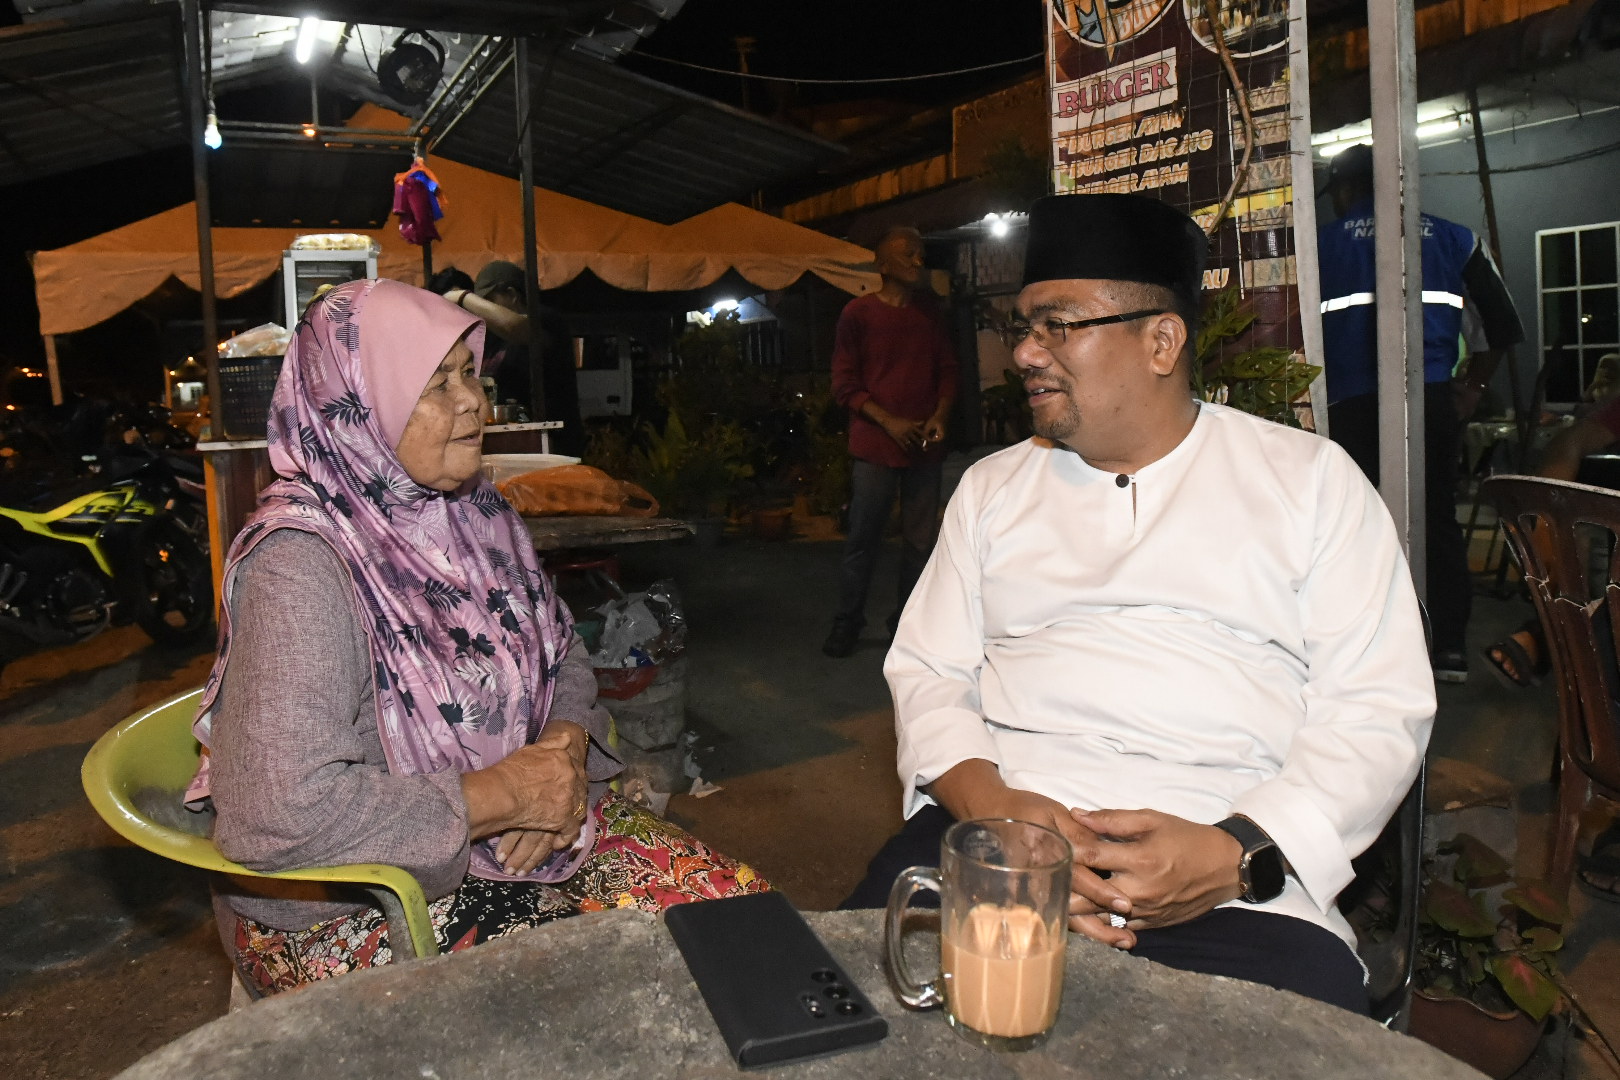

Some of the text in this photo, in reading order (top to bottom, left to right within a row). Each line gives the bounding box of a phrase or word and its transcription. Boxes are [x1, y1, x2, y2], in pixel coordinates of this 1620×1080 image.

[1058, 62, 1171, 118] BURGER
[1067, 122, 1136, 155] BURGER
[1069, 147, 1138, 179] BURGER
